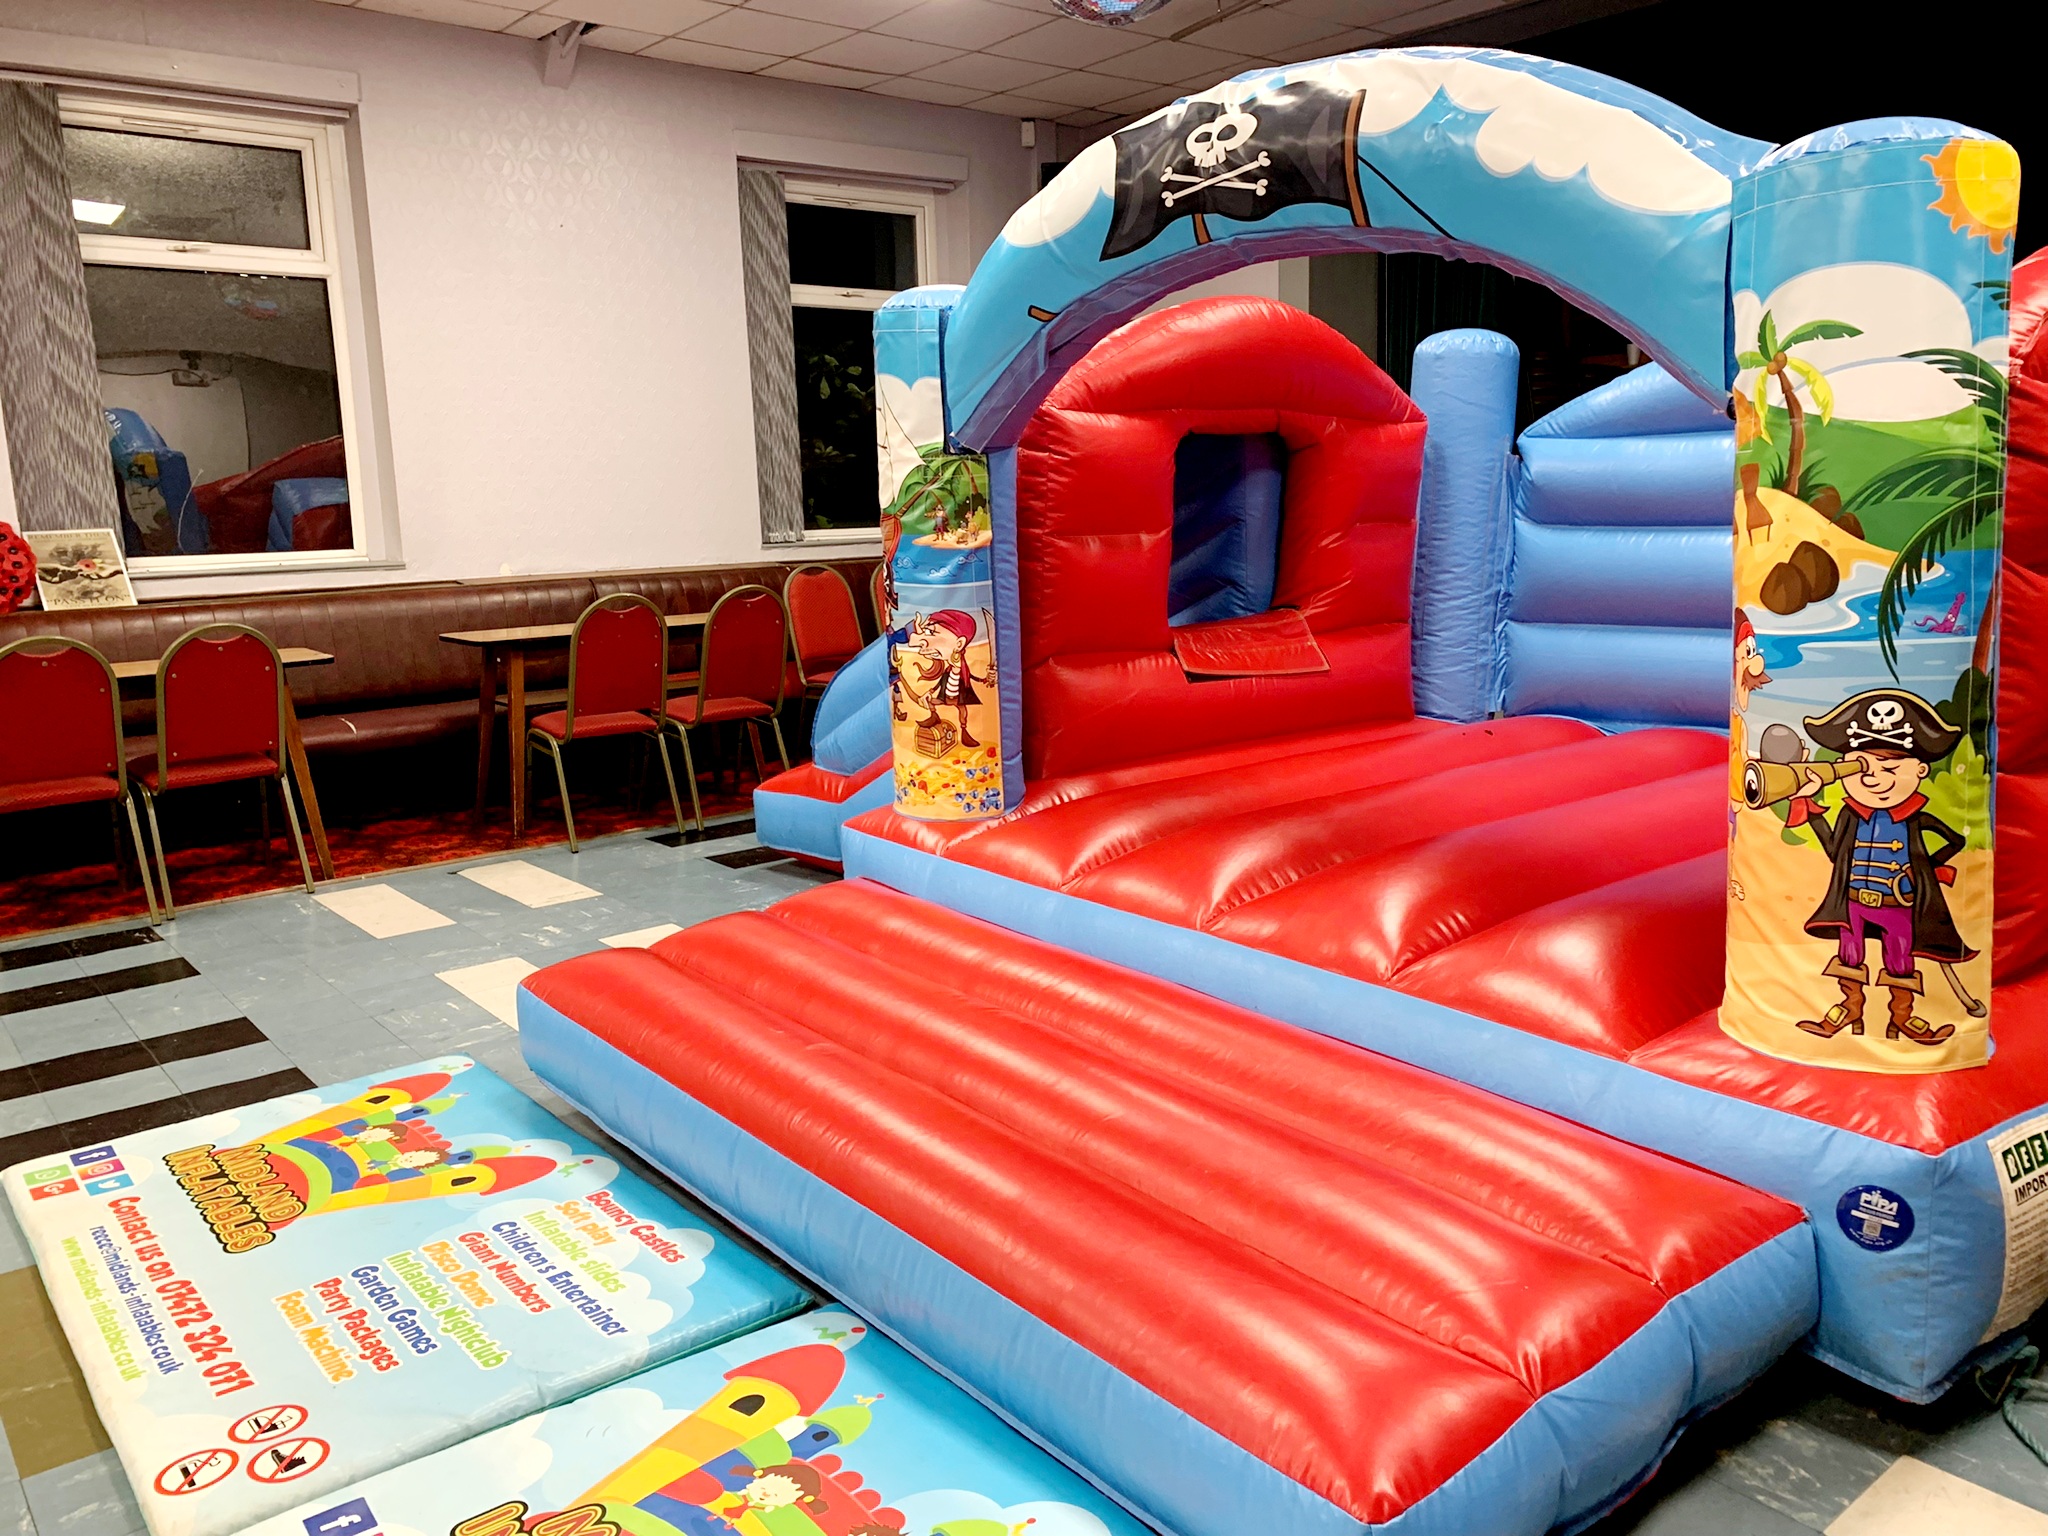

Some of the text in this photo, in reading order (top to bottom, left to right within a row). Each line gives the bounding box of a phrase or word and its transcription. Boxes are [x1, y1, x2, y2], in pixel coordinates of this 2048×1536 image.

[162, 1144, 276, 1253] INFLATABLES
[214, 1144, 306, 1222] MIDLAND
[2004, 1132, 2048, 1181] BEE
[522, 1210, 627, 1294] Inflatable slides
[554, 1200, 617, 1247] Soft play
[585, 1190, 686, 1264] Bouncy Castles
[107, 1196, 257, 1398] Contact us on 07472 324 071
[350, 1264, 439, 1355] Garden Games
[385, 1250, 509, 1369] Inflatable Nightclub
[421, 1240, 495, 1308] Disco Dome
[457, 1231, 552, 1314] Giant Numbers
[491, 1221, 629, 1337] Children's Entertainer
[274, 1290, 355, 1383] Foam Machine
[312, 1276, 400, 1373] Party Packages
